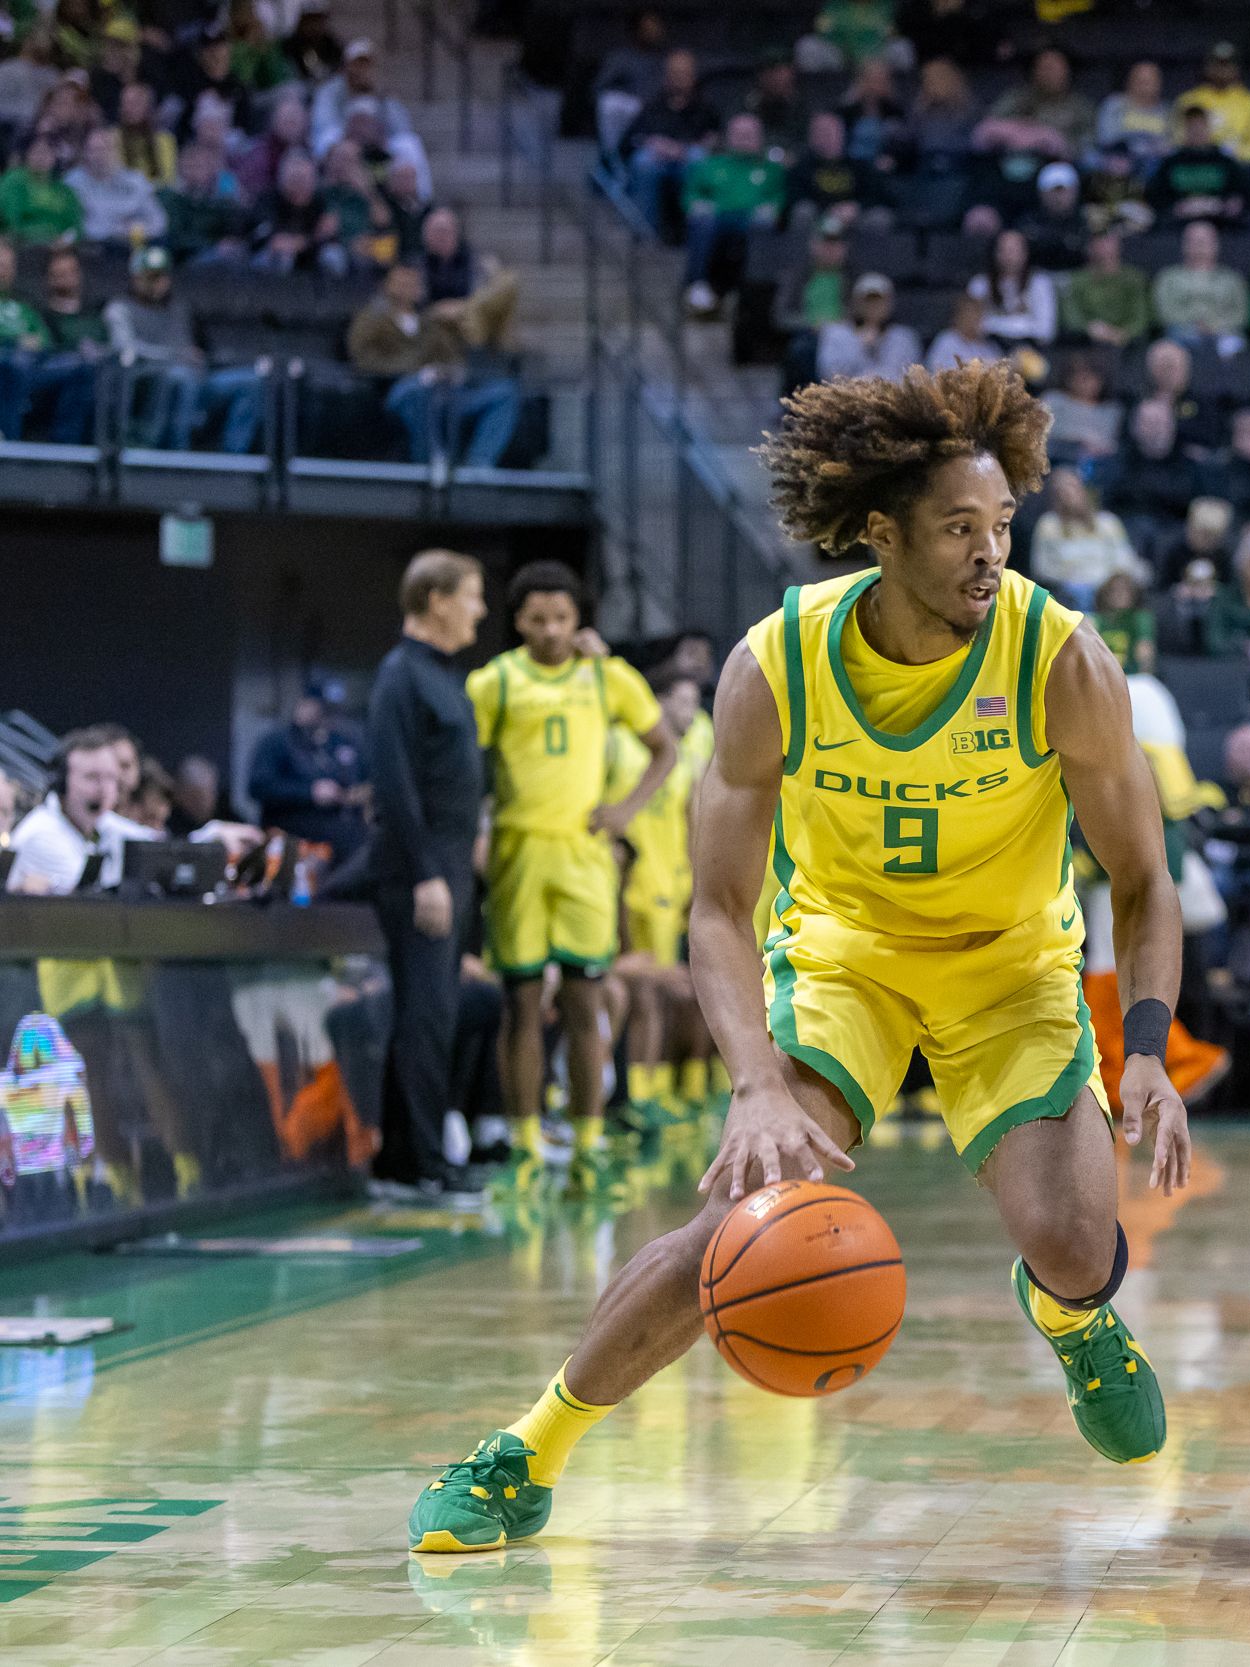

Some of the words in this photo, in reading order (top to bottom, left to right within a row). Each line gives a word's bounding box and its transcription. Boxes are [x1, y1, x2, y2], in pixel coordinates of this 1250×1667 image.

[545, 714, 568, 757] 0
[814, 768, 1009, 802] DUCKS
[883, 806, 938, 874] 9
